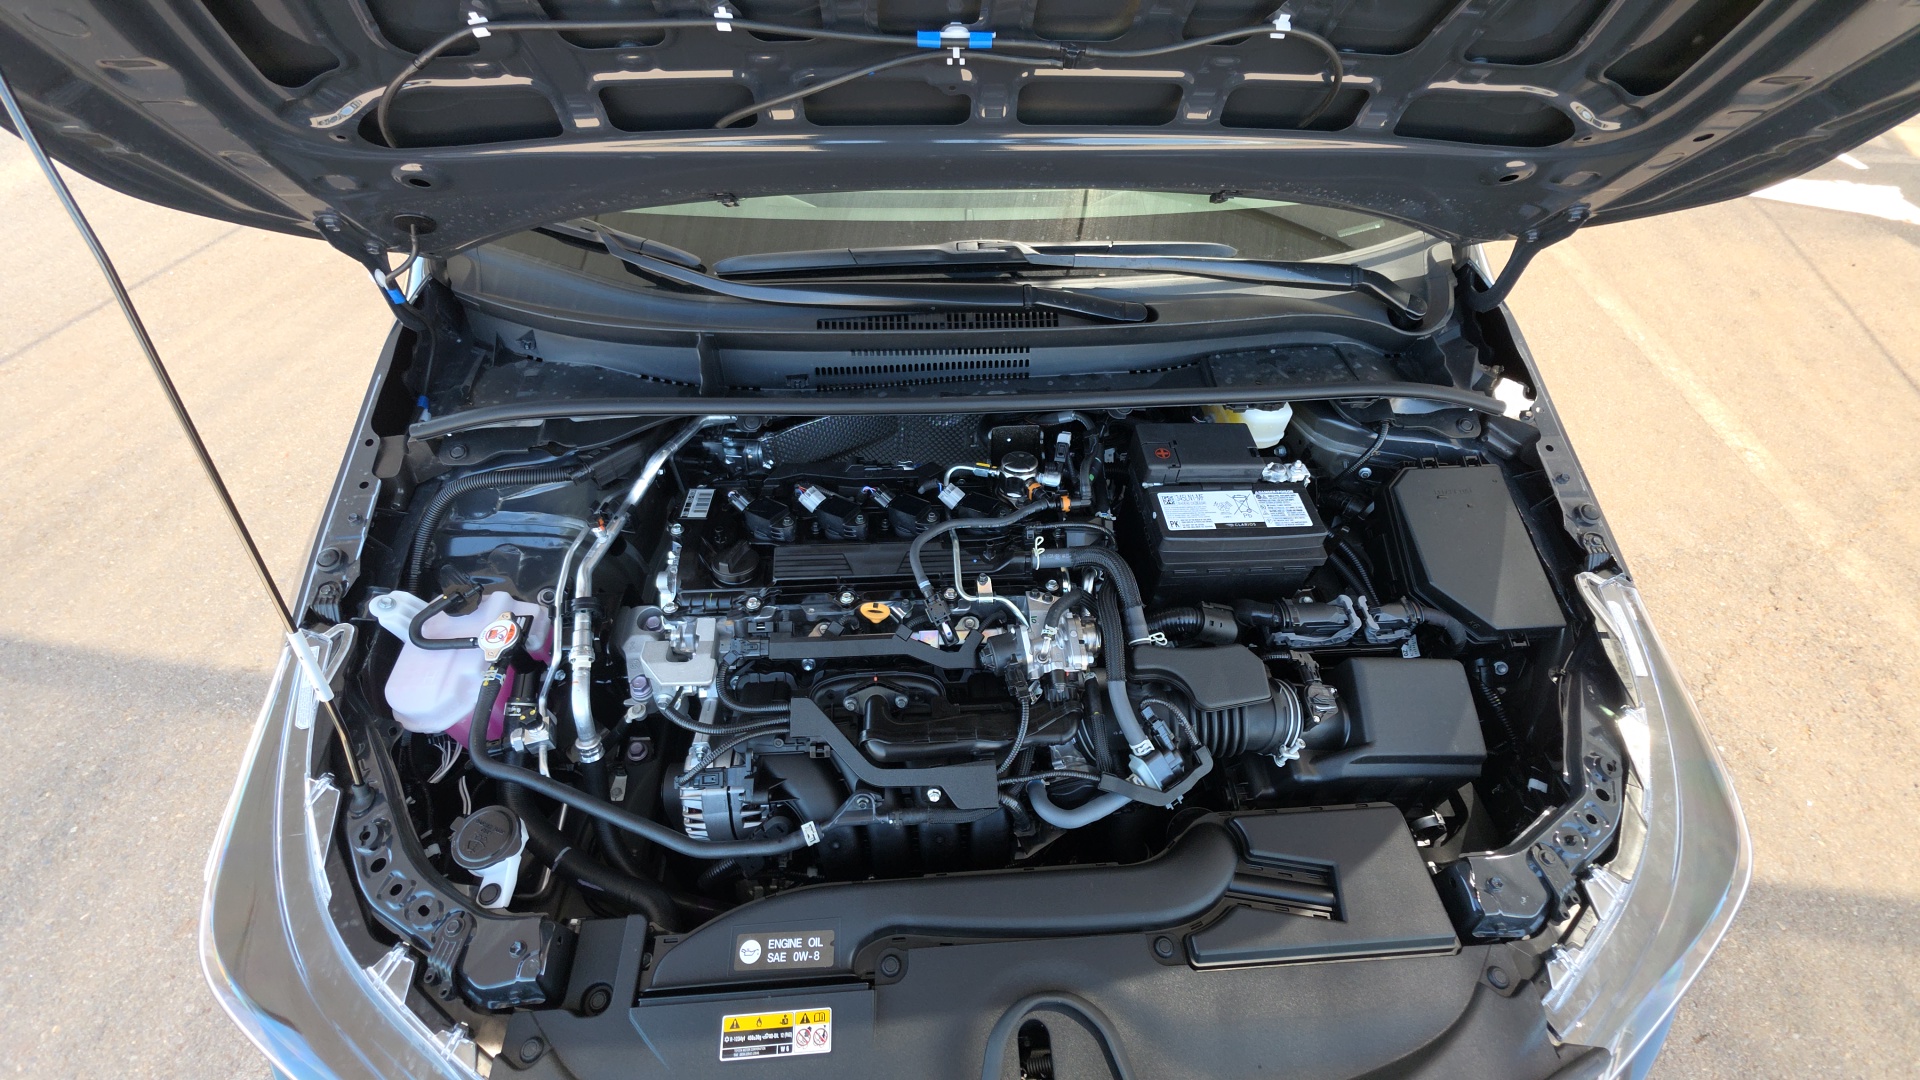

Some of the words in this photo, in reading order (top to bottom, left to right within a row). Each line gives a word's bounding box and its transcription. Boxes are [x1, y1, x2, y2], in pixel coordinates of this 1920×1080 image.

[1169, 520, 1180, 528] PK
[768, 938, 803, 950] ENGINE
[807, 937, 824, 948] OIL
[766, 952, 787, 963] SAE
[793, 951, 820, 962] 0W-8
